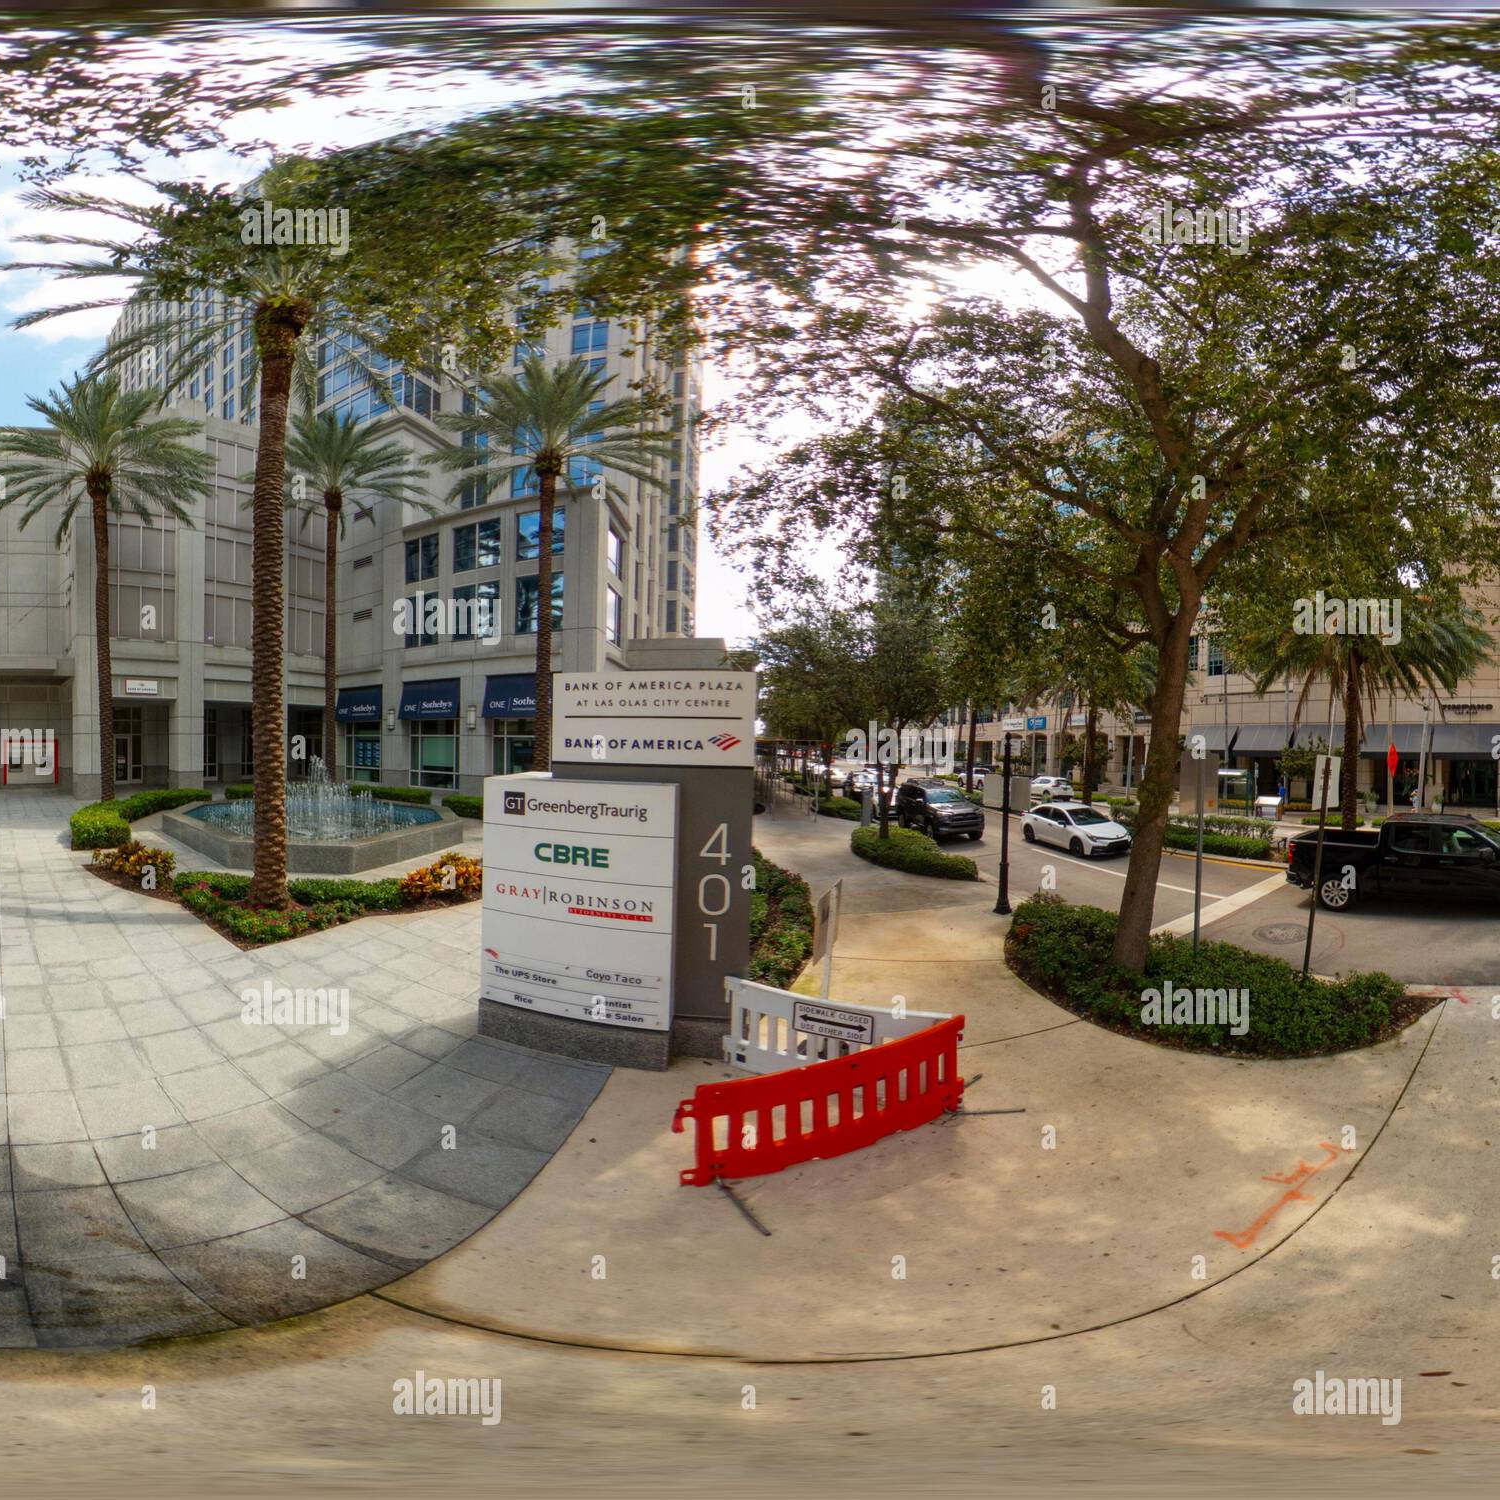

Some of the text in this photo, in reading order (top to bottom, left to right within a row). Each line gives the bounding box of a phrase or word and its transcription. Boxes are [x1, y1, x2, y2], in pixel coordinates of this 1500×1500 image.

[565, 681, 743, 691] BANK OF AMERICA PLAZA
[404, 704, 417, 712] ONE
[421, 700, 453, 710] Sotheby's
[489, 700, 507, 709] ONE
[565, 738, 704, 750] BANK OF AMERICA
[505, 796, 524, 810] GT
[534, 842, 610, 869] CBRE
[494, 965, 557, 985] The UPS Store
[586, 969, 643, 985] Coyo Taco
[513, 994, 533, 1004] Rice
[615, 1012, 644, 1023] Salon
[798, 1005, 869, 1024] SIDEWALK CLOSED
[800, 1022, 864, 1041] USE OTHER SIDE
